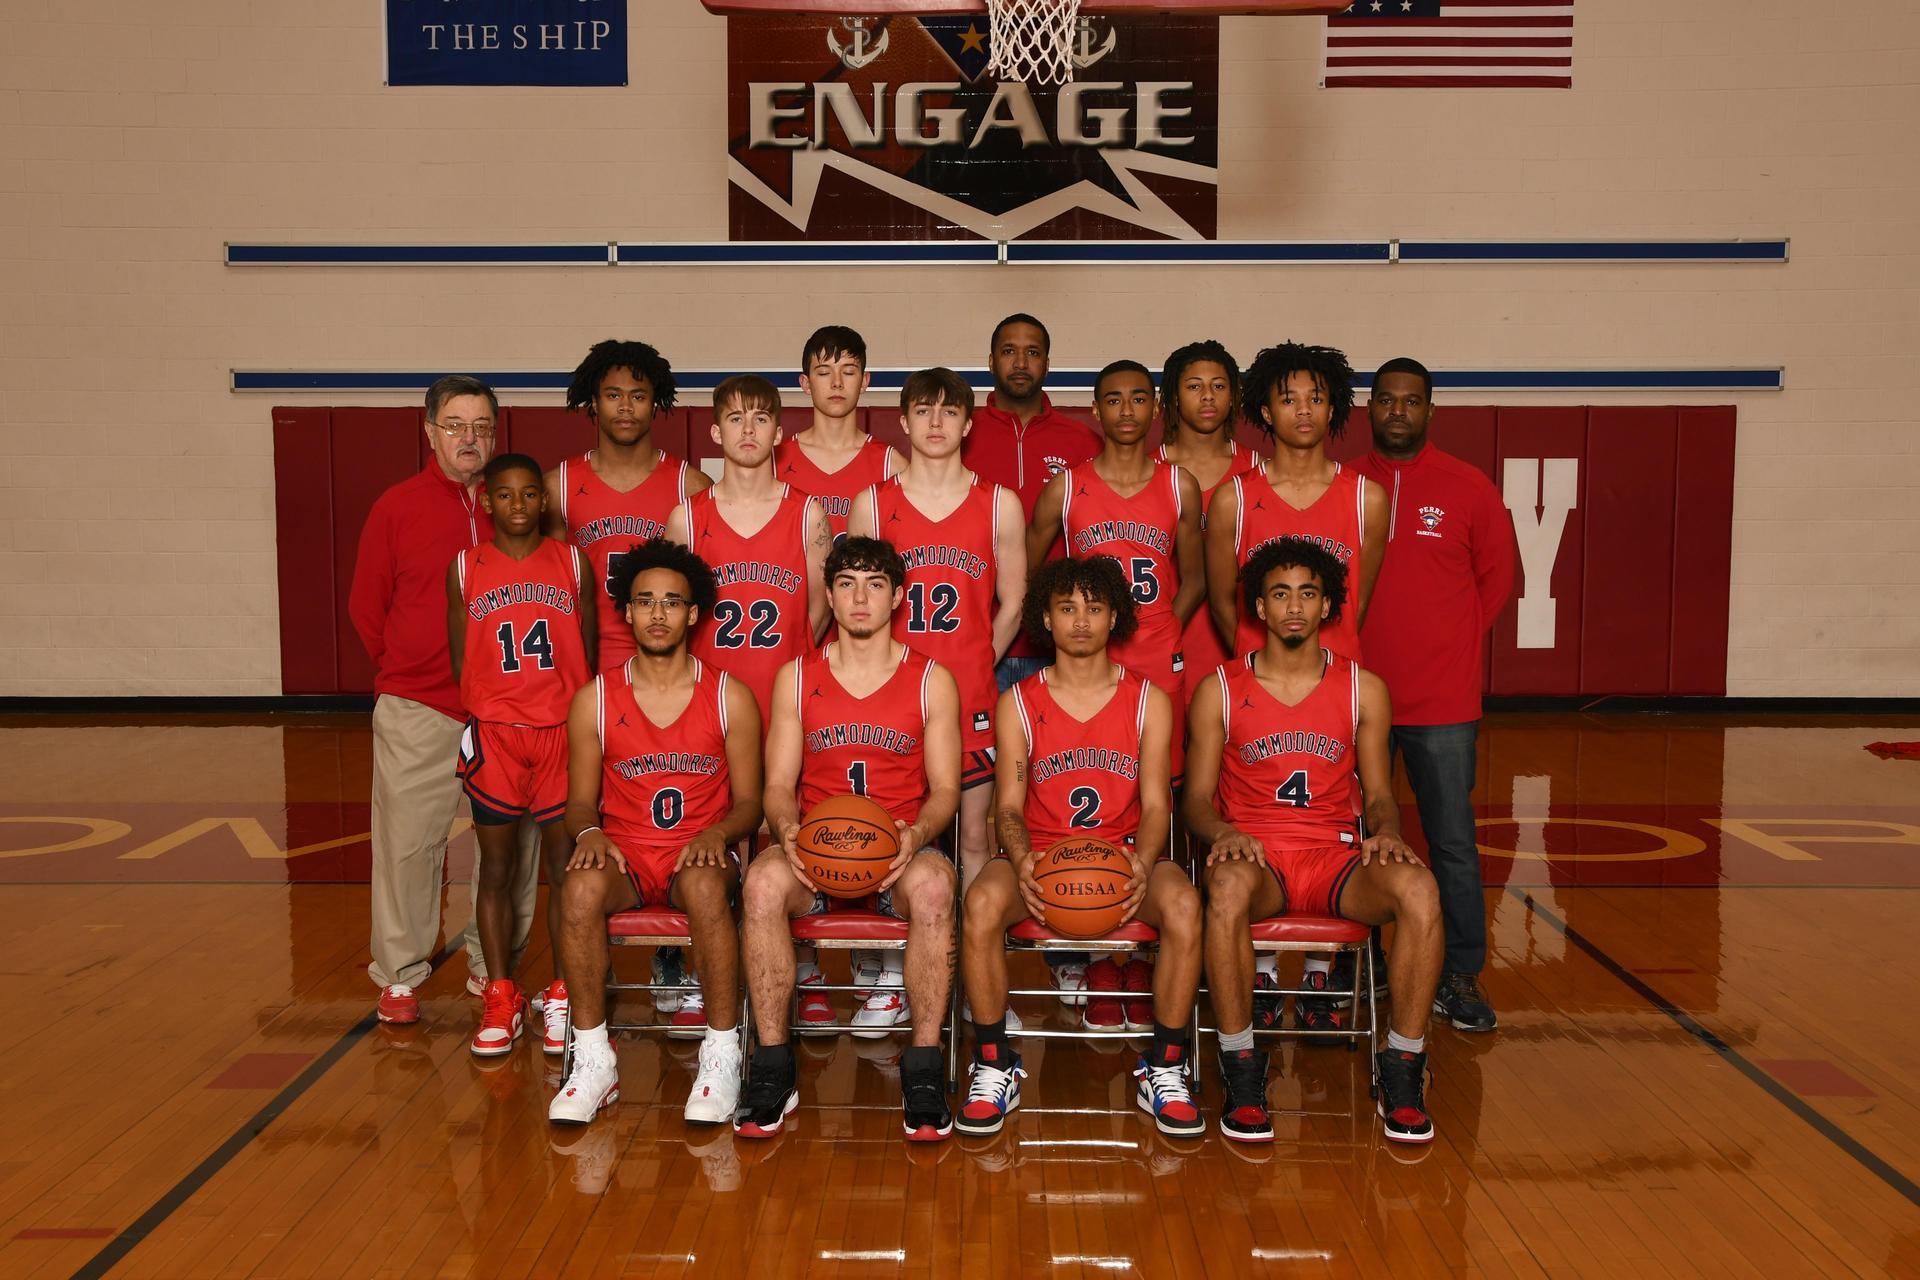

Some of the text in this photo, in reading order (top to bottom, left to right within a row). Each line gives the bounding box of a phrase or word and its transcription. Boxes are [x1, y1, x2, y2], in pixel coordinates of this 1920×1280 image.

[422, 20, 610, 50] THE SHIP
[747, 81, 1196, 150] ENGAGE
[1043, 456, 1067, 465] PERRY
[1418, 506, 1445, 517] PERRY
[575, 516, 667, 548] COMMODORE
[711, 561, 802, 594] MMODORES
[901, 545, 988, 580] MMODORES
[468, 582, 575, 621] COMMODORES
[907, 582, 961, 633] 12
[713, 599, 782, 649] 22
[496, 618, 555, 673] 14
[847, 760, 871, 798] 1
[1033, 747, 1140, 784] COMMODORES
[1068, 785, 1103, 829] 2
[1275, 770, 1312, 808] 4
[650, 786, 685, 830] 0
[812, 825, 878, 850] Rawlings
[1052, 842, 1116, 865] Rawlings
[813, 865, 873, 882] OHSAA
[1055, 882, 1117, 896] OHSAA
